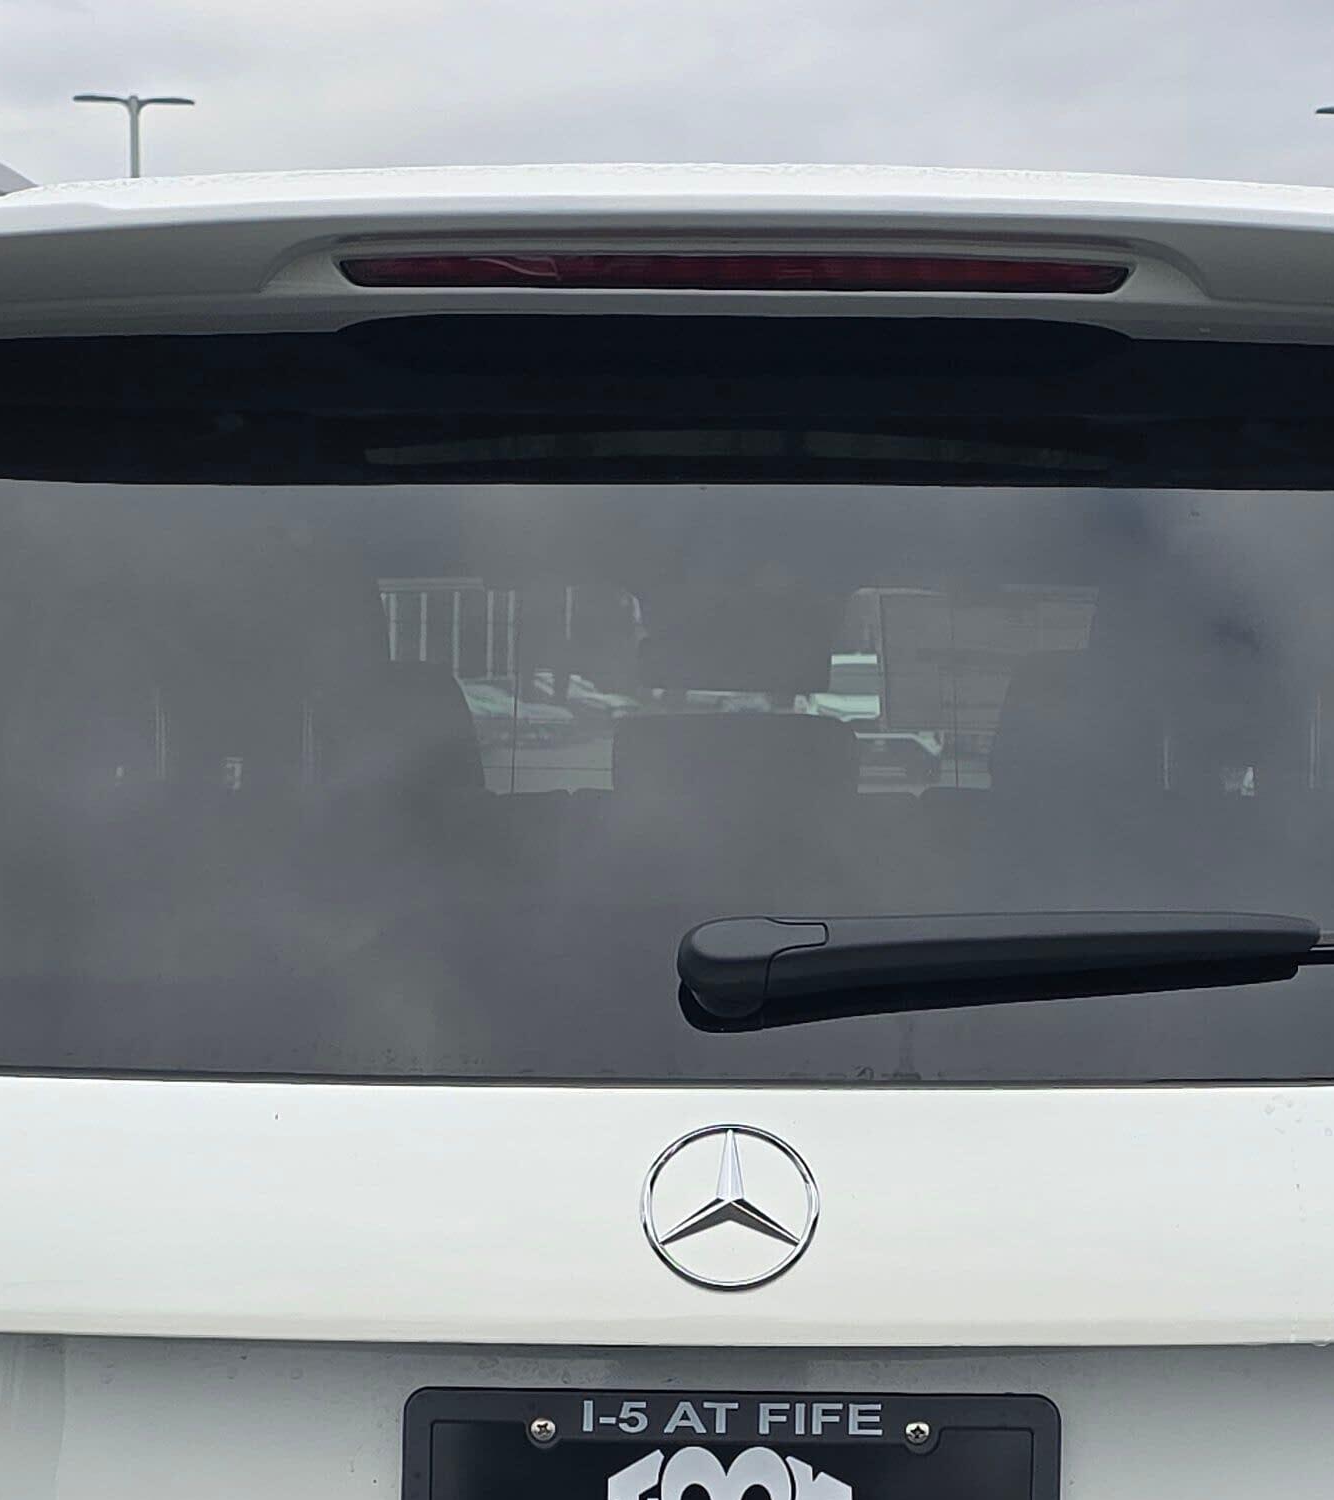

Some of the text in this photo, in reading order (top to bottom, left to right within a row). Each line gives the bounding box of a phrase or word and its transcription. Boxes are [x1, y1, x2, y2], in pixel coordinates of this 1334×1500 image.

[581, 1399, 884, 1438] I-5 AT FIFE
